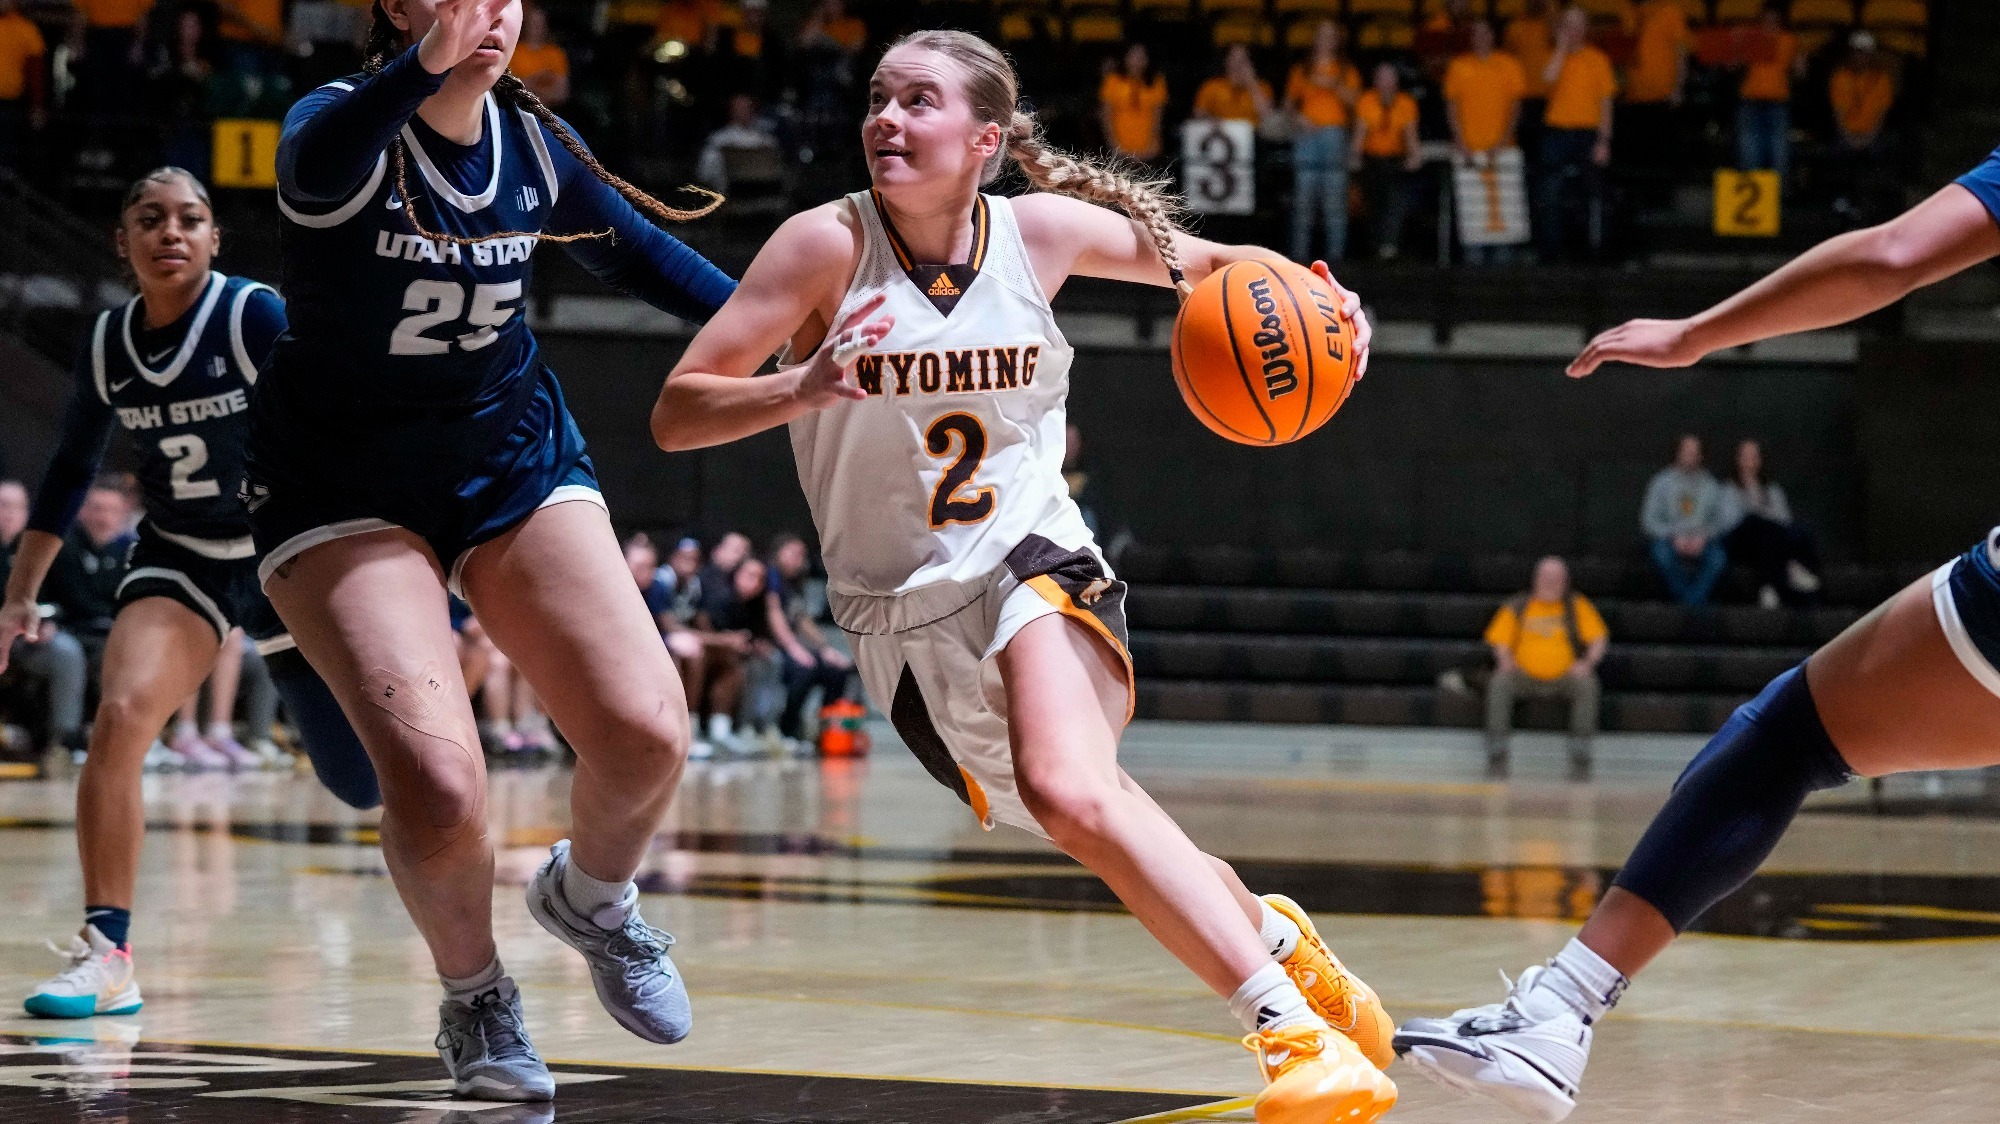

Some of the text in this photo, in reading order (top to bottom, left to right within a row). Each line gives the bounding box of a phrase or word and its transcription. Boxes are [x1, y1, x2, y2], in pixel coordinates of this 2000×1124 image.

[239, 130, 254, 178] 1
[1199, 128, 1235, 203] 3
[1733, 178, 1763, 227] 2
[375, 229, 462, 266] UTAH
[928, 286, 961, 296] adidas
[388, 278, 523, 356] 25
[1246, 276, 1300, 401] Wilson
[855, 345, 1042, 397] WYOMING
[168, 388, 249, 425] STATE
[158, 433, 221, 500] 2
[923, 410, 996, 530] 2
[383, 684, 396, 699] KT
[428, 678, 441, 691] KT
